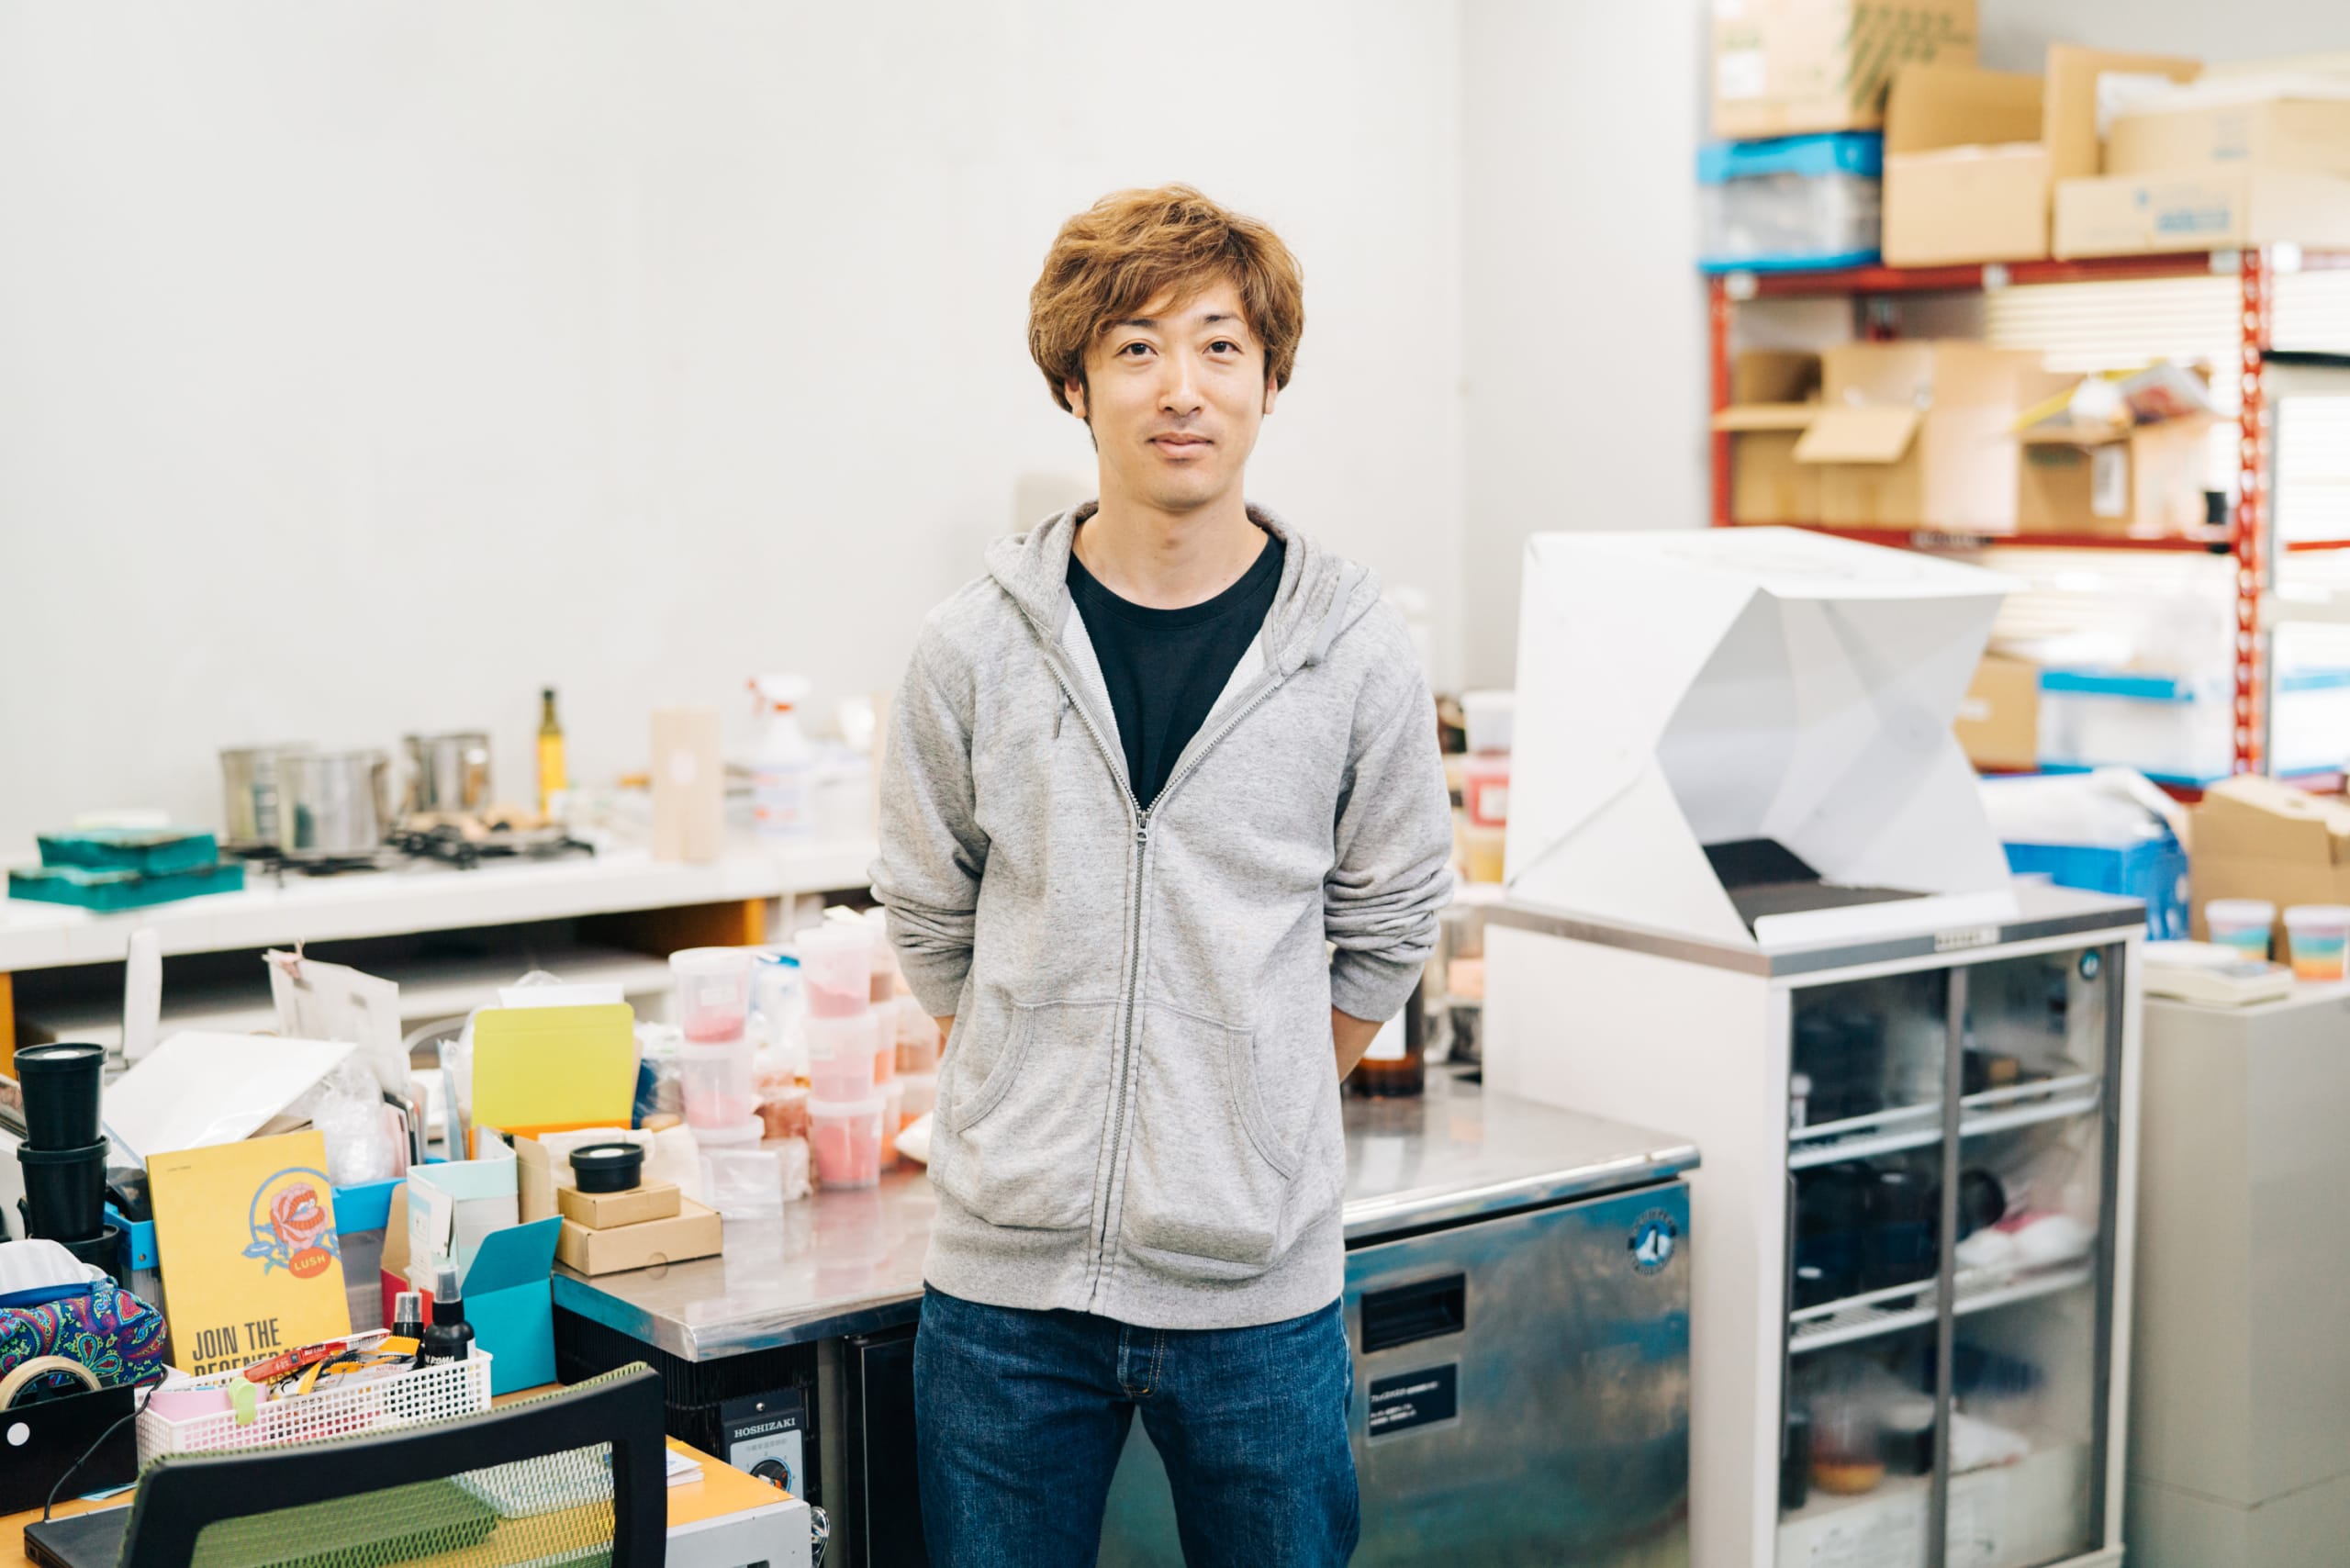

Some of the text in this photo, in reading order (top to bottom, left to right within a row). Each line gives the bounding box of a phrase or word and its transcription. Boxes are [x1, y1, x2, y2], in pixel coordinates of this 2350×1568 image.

[294, 1254, 326, 1271] LUSH
[192, 1326, 239, 1361] JOIN
[244, 1317, 282, 1350] THE
[734, 1417, 796, 1439] HOSHIZAKI
